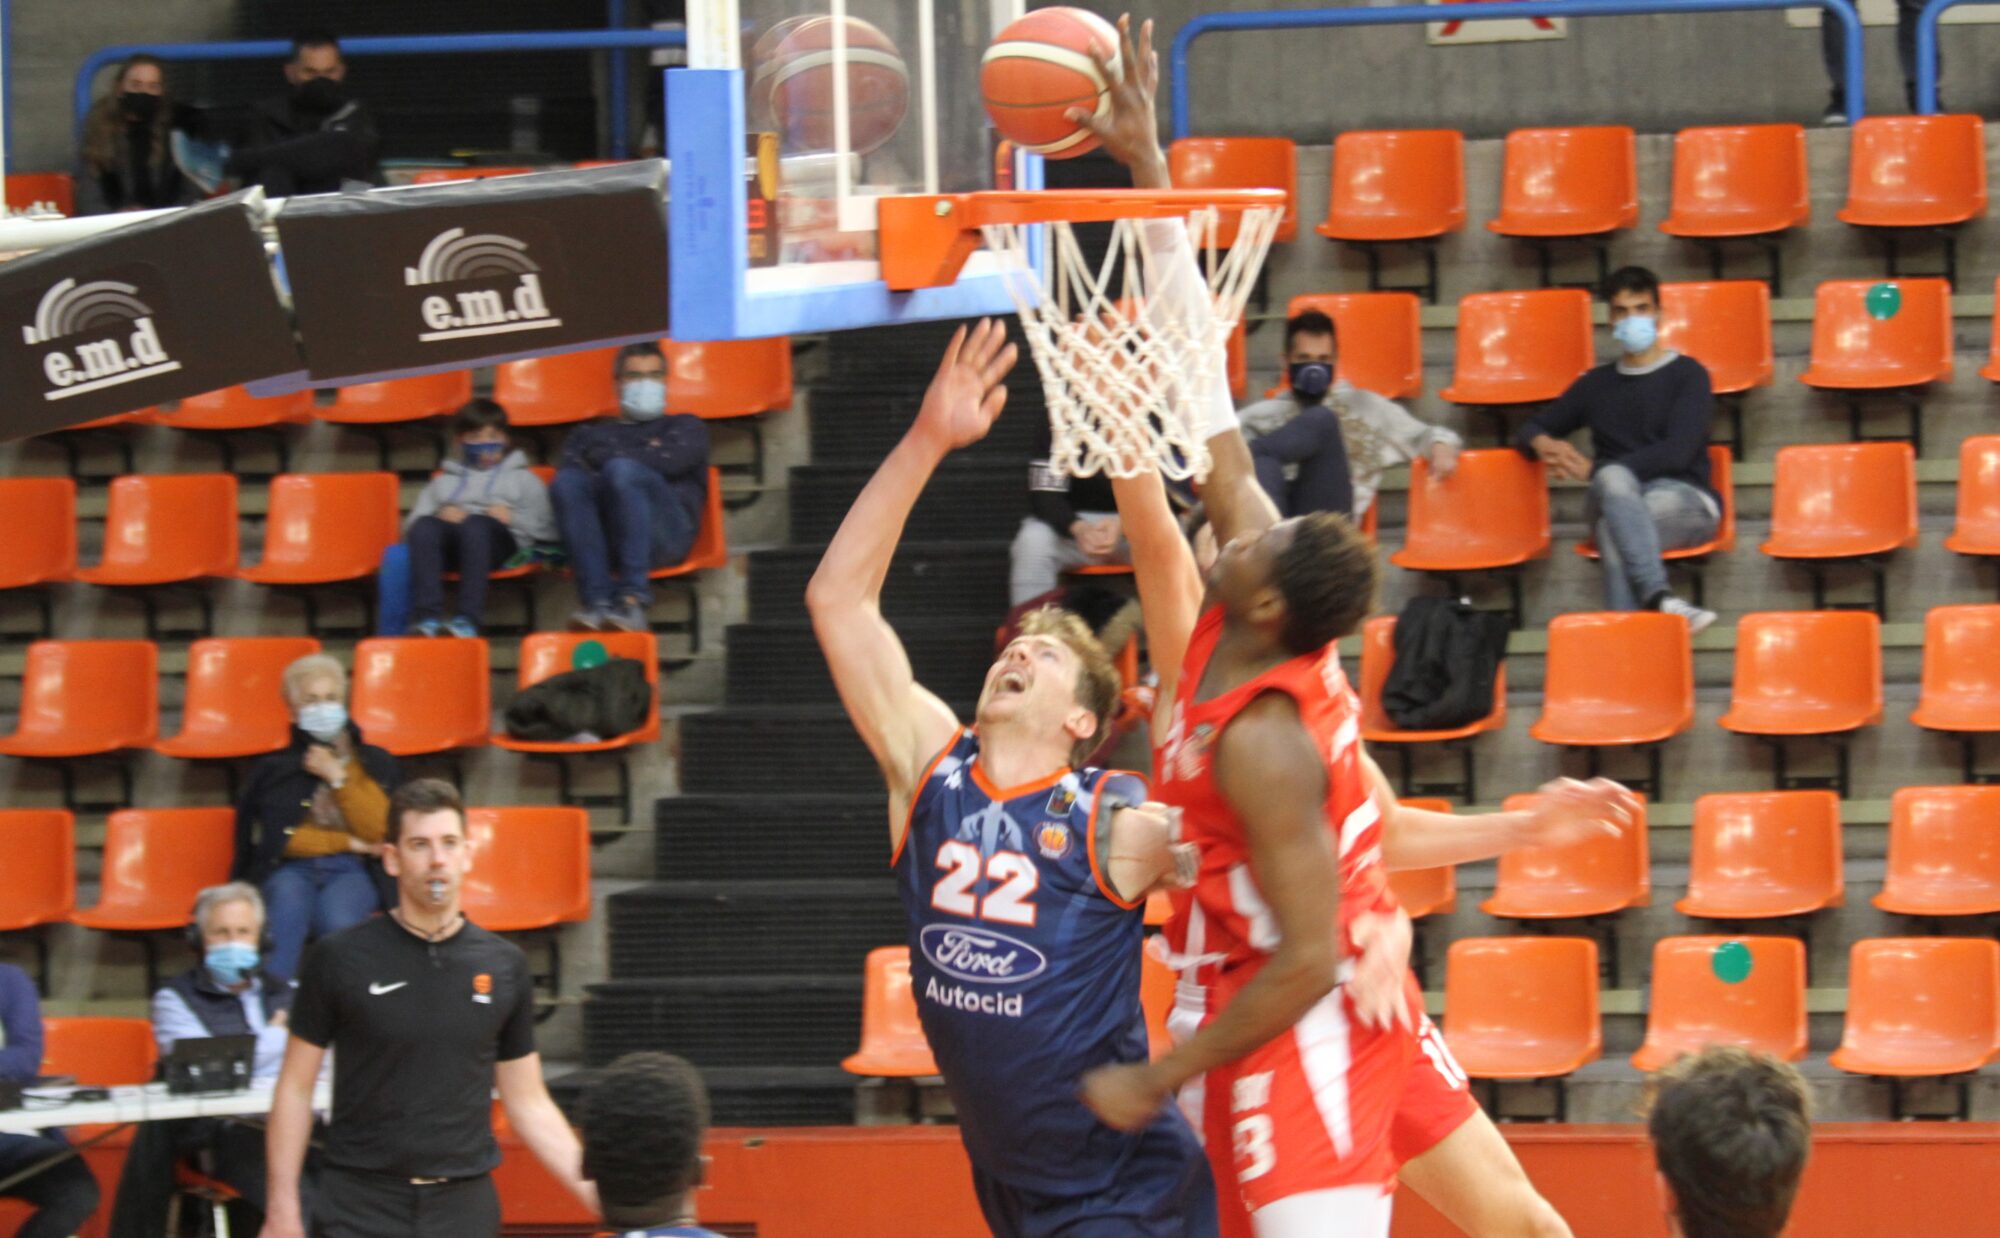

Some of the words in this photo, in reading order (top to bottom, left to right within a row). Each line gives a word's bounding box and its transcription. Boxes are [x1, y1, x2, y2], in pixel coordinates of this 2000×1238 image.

[422, 273, 550, 330] e.m.d
[44, 317, 168, 386] e.m.d
[931, 840, 1040, 926] 22
[936, 932, 1017, 977] Ford
[926, 977, 1023, 1017] Autocid
